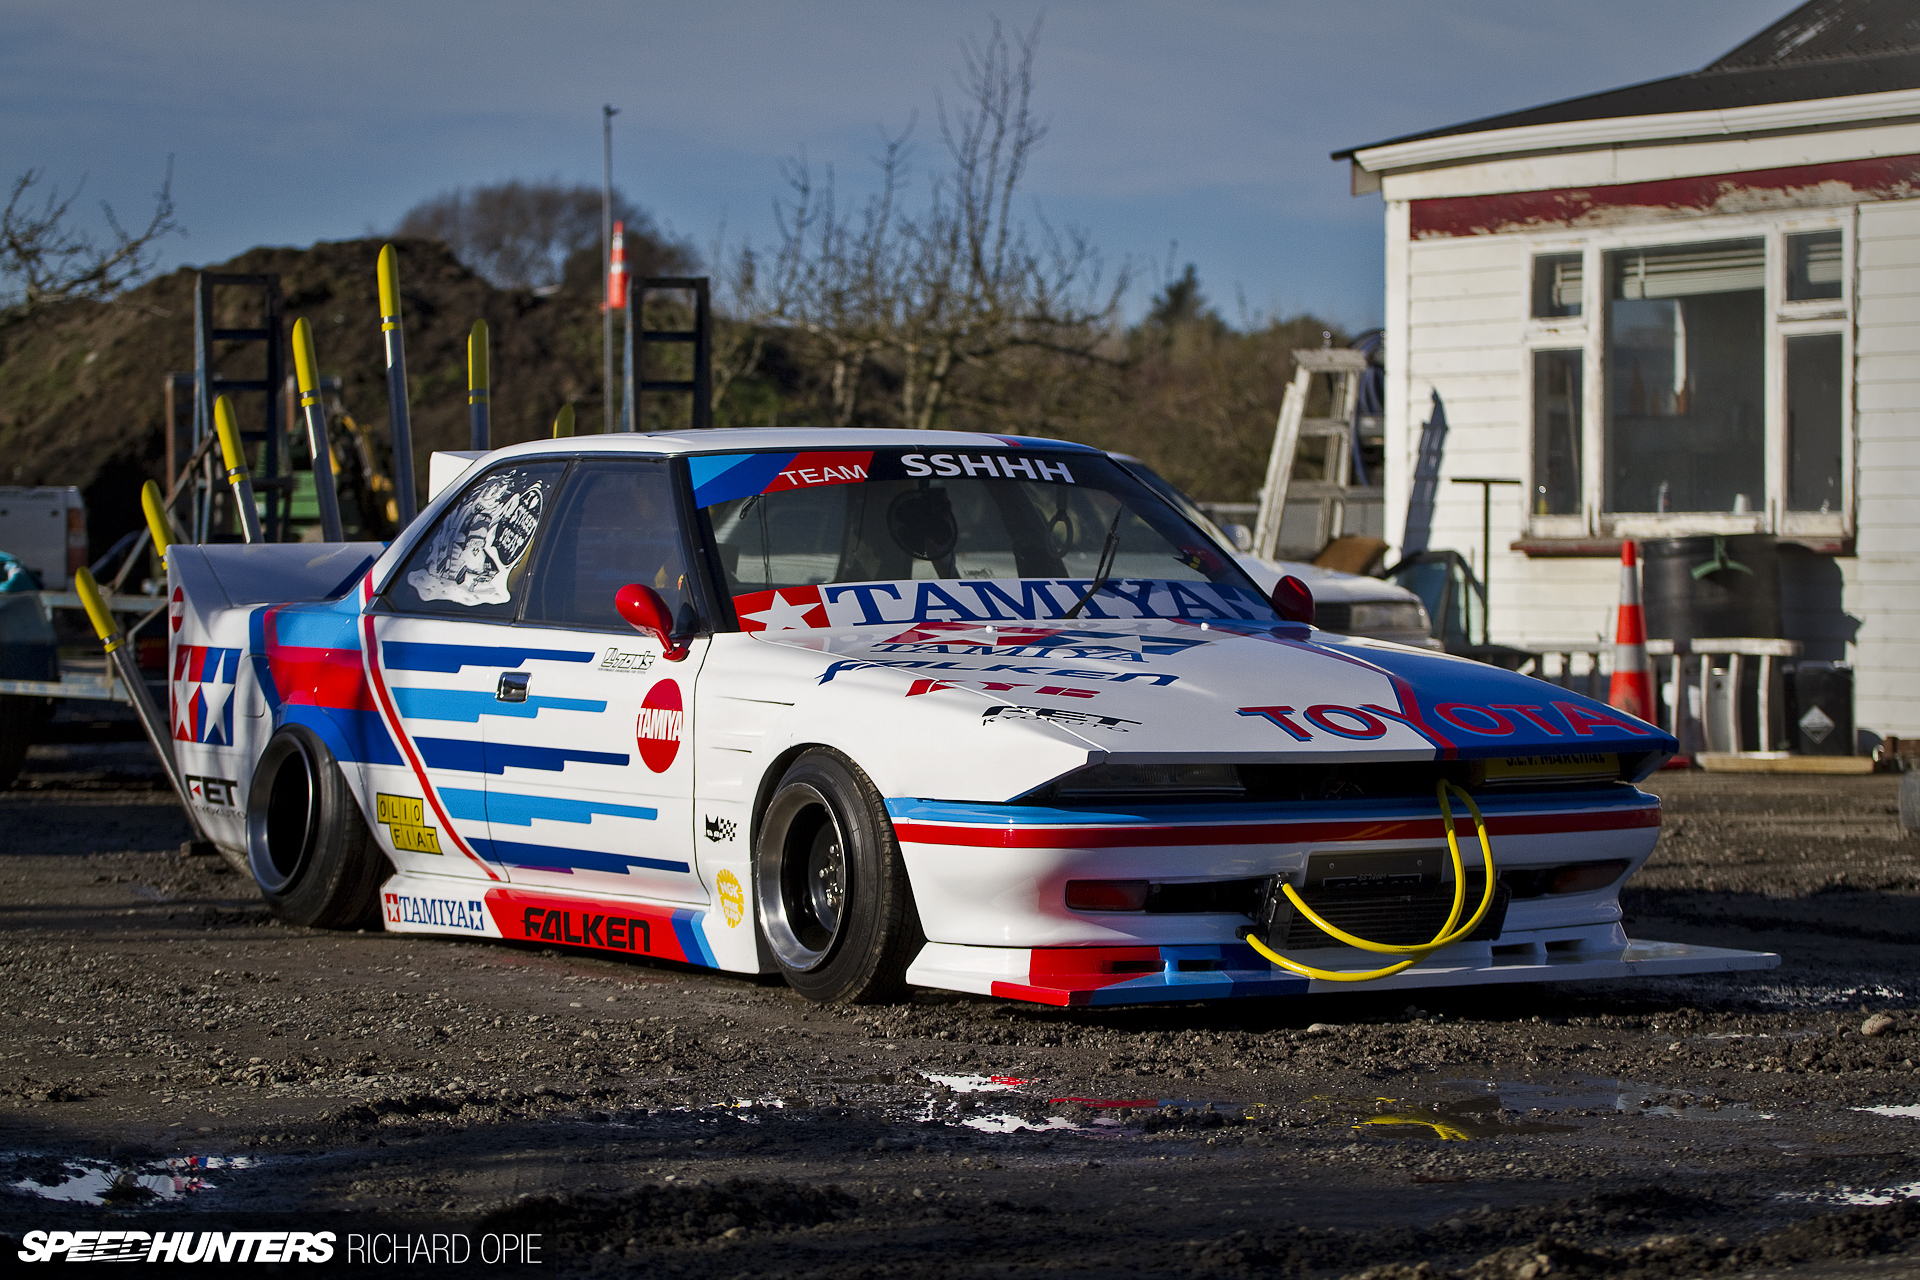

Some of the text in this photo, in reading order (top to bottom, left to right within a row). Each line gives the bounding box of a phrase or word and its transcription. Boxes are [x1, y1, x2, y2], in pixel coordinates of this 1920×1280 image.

[778, 453, 1076, 485] TEAM SSHHH
[825, 580, 1234, 626] TAMIYA
[869, 643, 1150, 664] TAMIYA
[815, 659, 1180, 687] FALKEN
[904, 679, 1102, 698] KYB
[635, 707, 684, 742] TAMIYA
[1236, 700, 1652, 760] TOYOTA
[380, 800, 421, 822] OLIO
[393, 828, 435, 849] FIAT
[719, 881, 739, 900] NGK
[398, 895, 471, 929] TAMIYA
[520, 906, 651, 952] FALKEN
